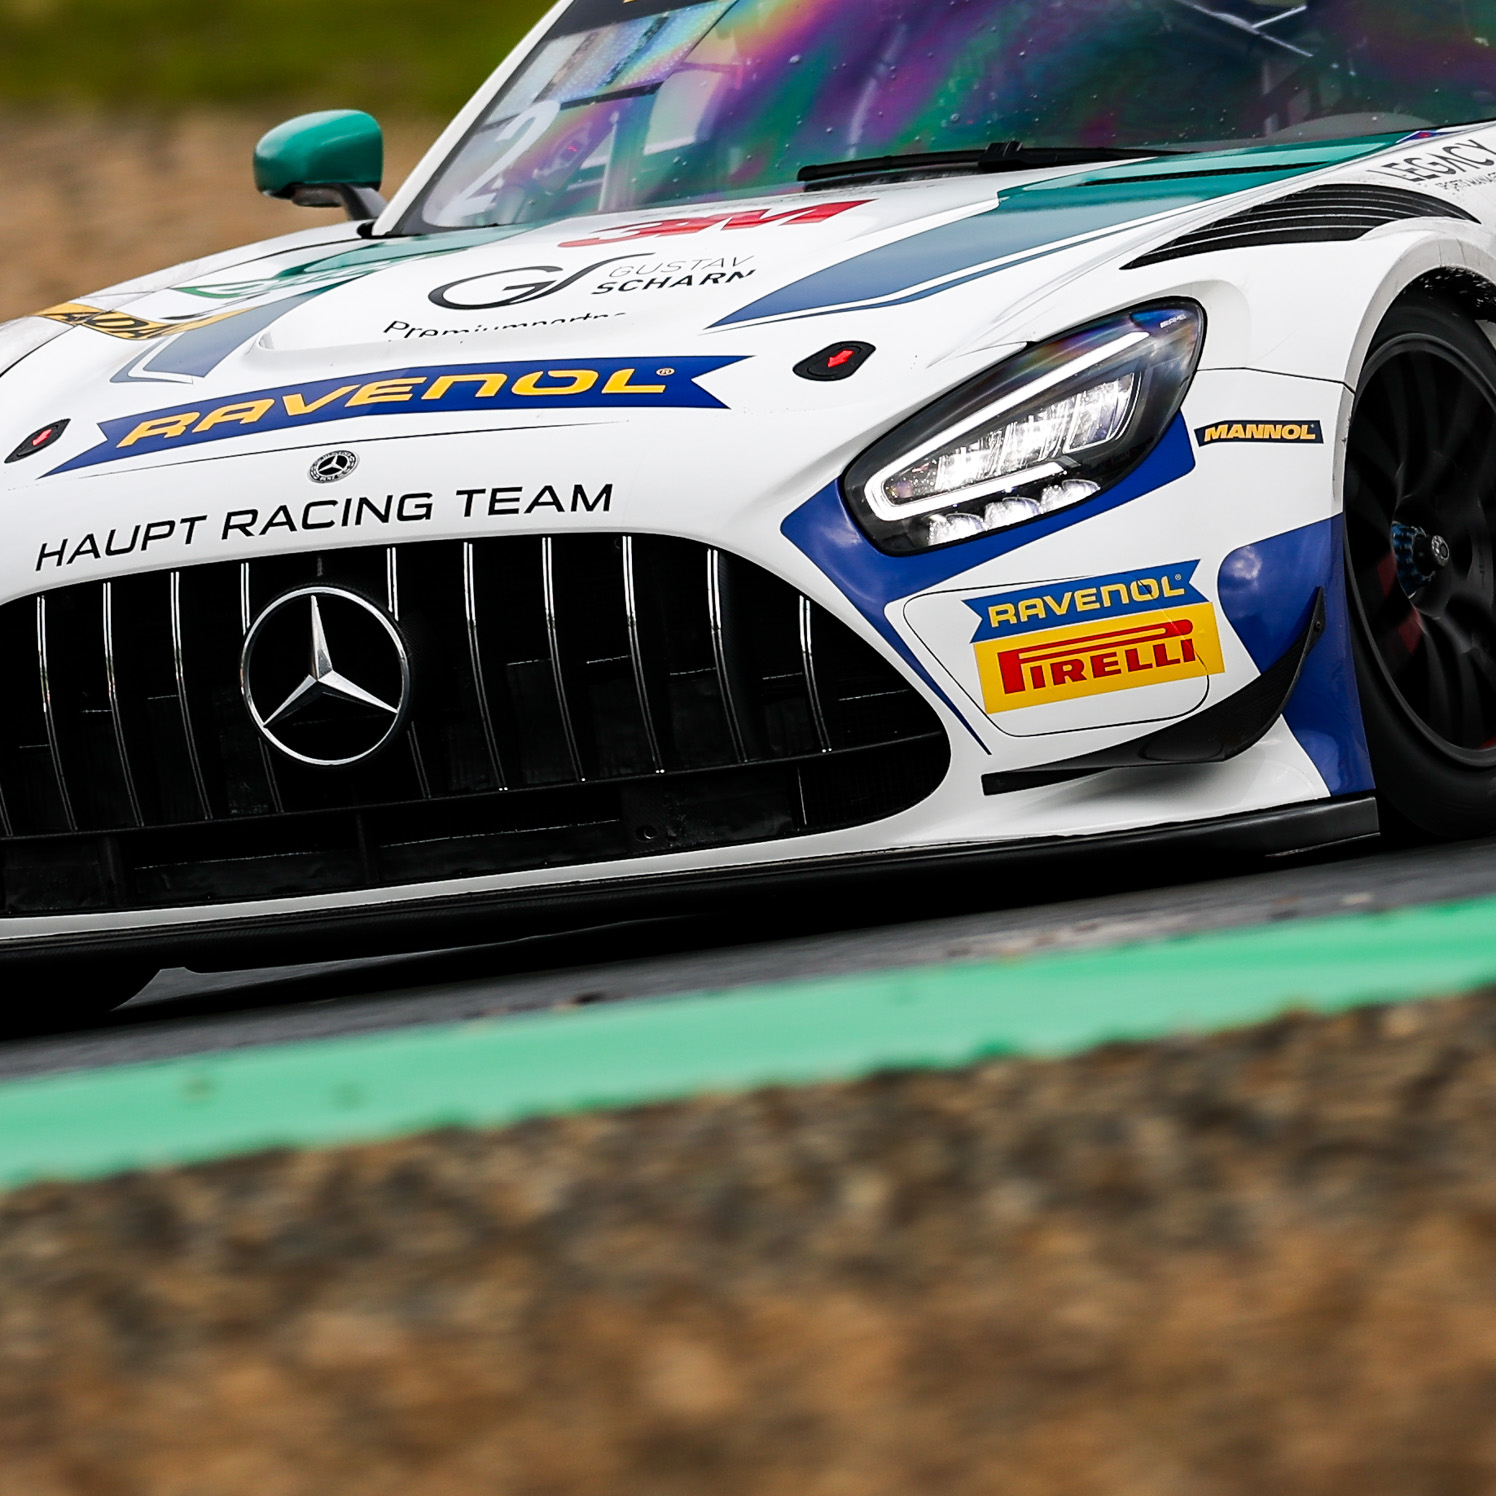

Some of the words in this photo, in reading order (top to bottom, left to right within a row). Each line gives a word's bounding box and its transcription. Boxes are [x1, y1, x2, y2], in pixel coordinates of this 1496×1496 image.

[557, 198, 879, 248] 3M
[608, 255, 755, 278] GUSTAV
[115, 367, 675, 448] RAVENOL
[1203, 423, 1316, 443] MANNOL
[35, 515, 207, 573] HAUPT
[221, 490, 435, 541] RACING
[462, 482, 614, 517] TEAM
[987, 576, 1185, 629] RAVENOL
[996, 619, 1194, 695] PIRELLI
